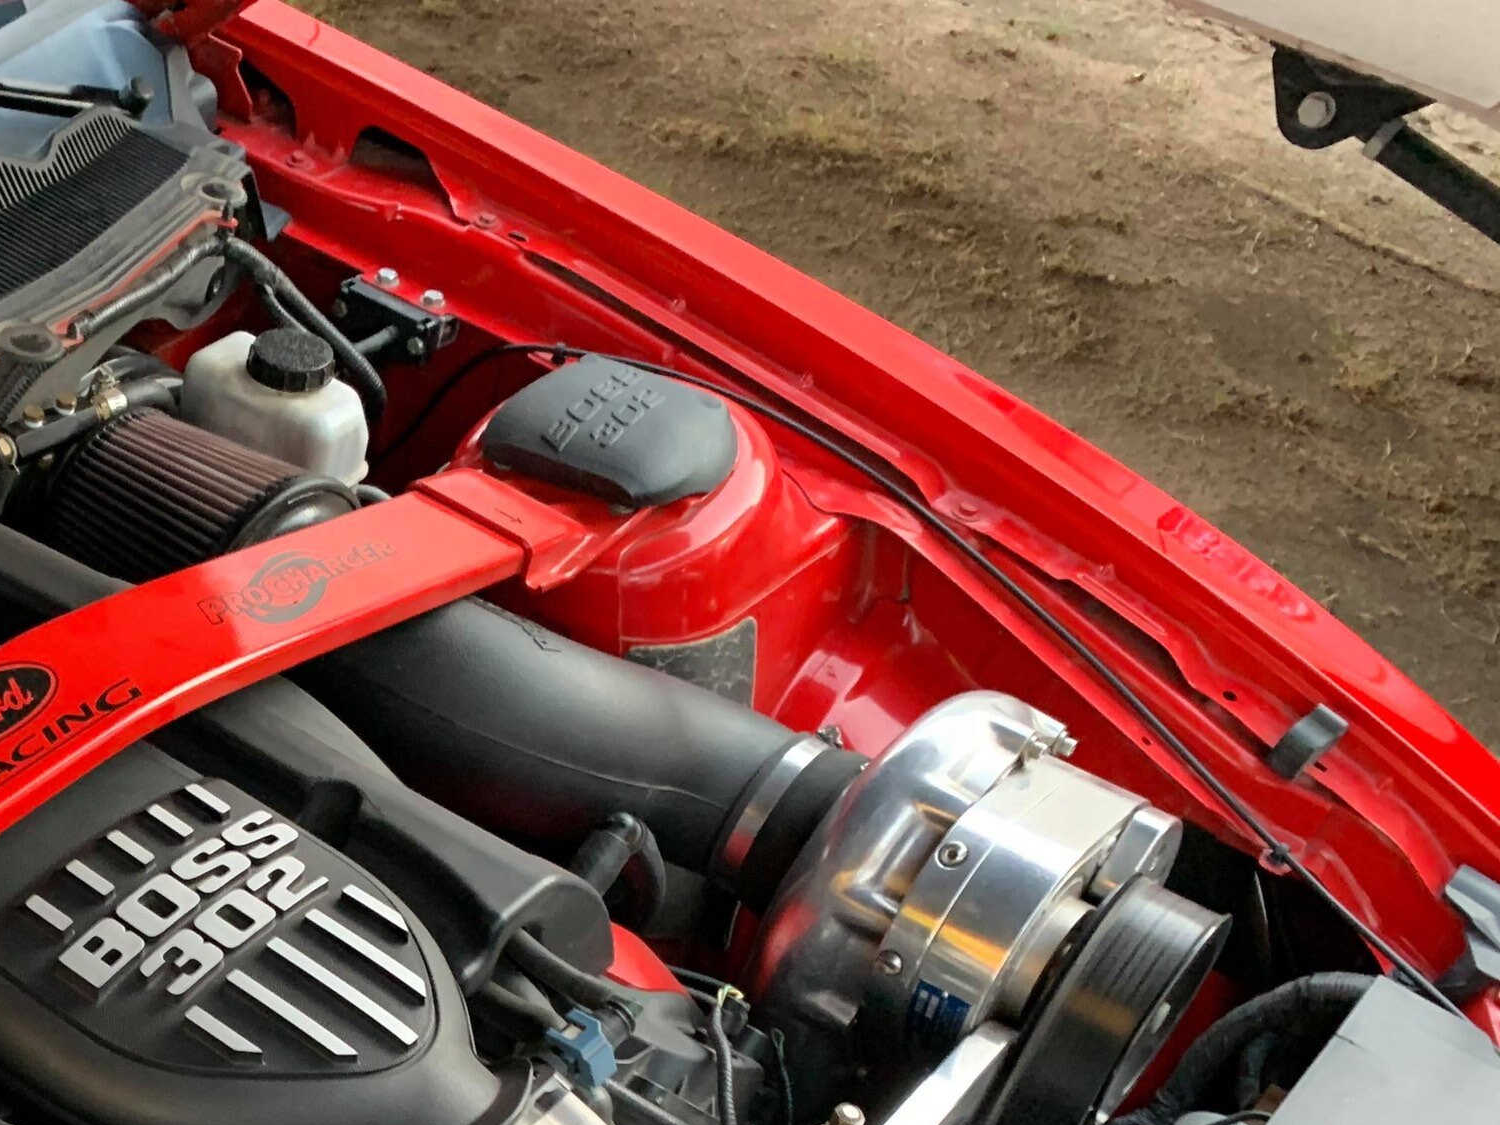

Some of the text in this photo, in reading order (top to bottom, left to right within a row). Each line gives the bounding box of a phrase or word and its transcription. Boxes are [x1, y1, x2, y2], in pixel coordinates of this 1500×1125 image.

[540, 366, 645, 453] BOSS
[588, 388, 667, 449] 302
[196, 539, 398, 626] PROCHARGER
[58, 810, 300, 989] BOSS
[139, 855, 330, 996] 302
